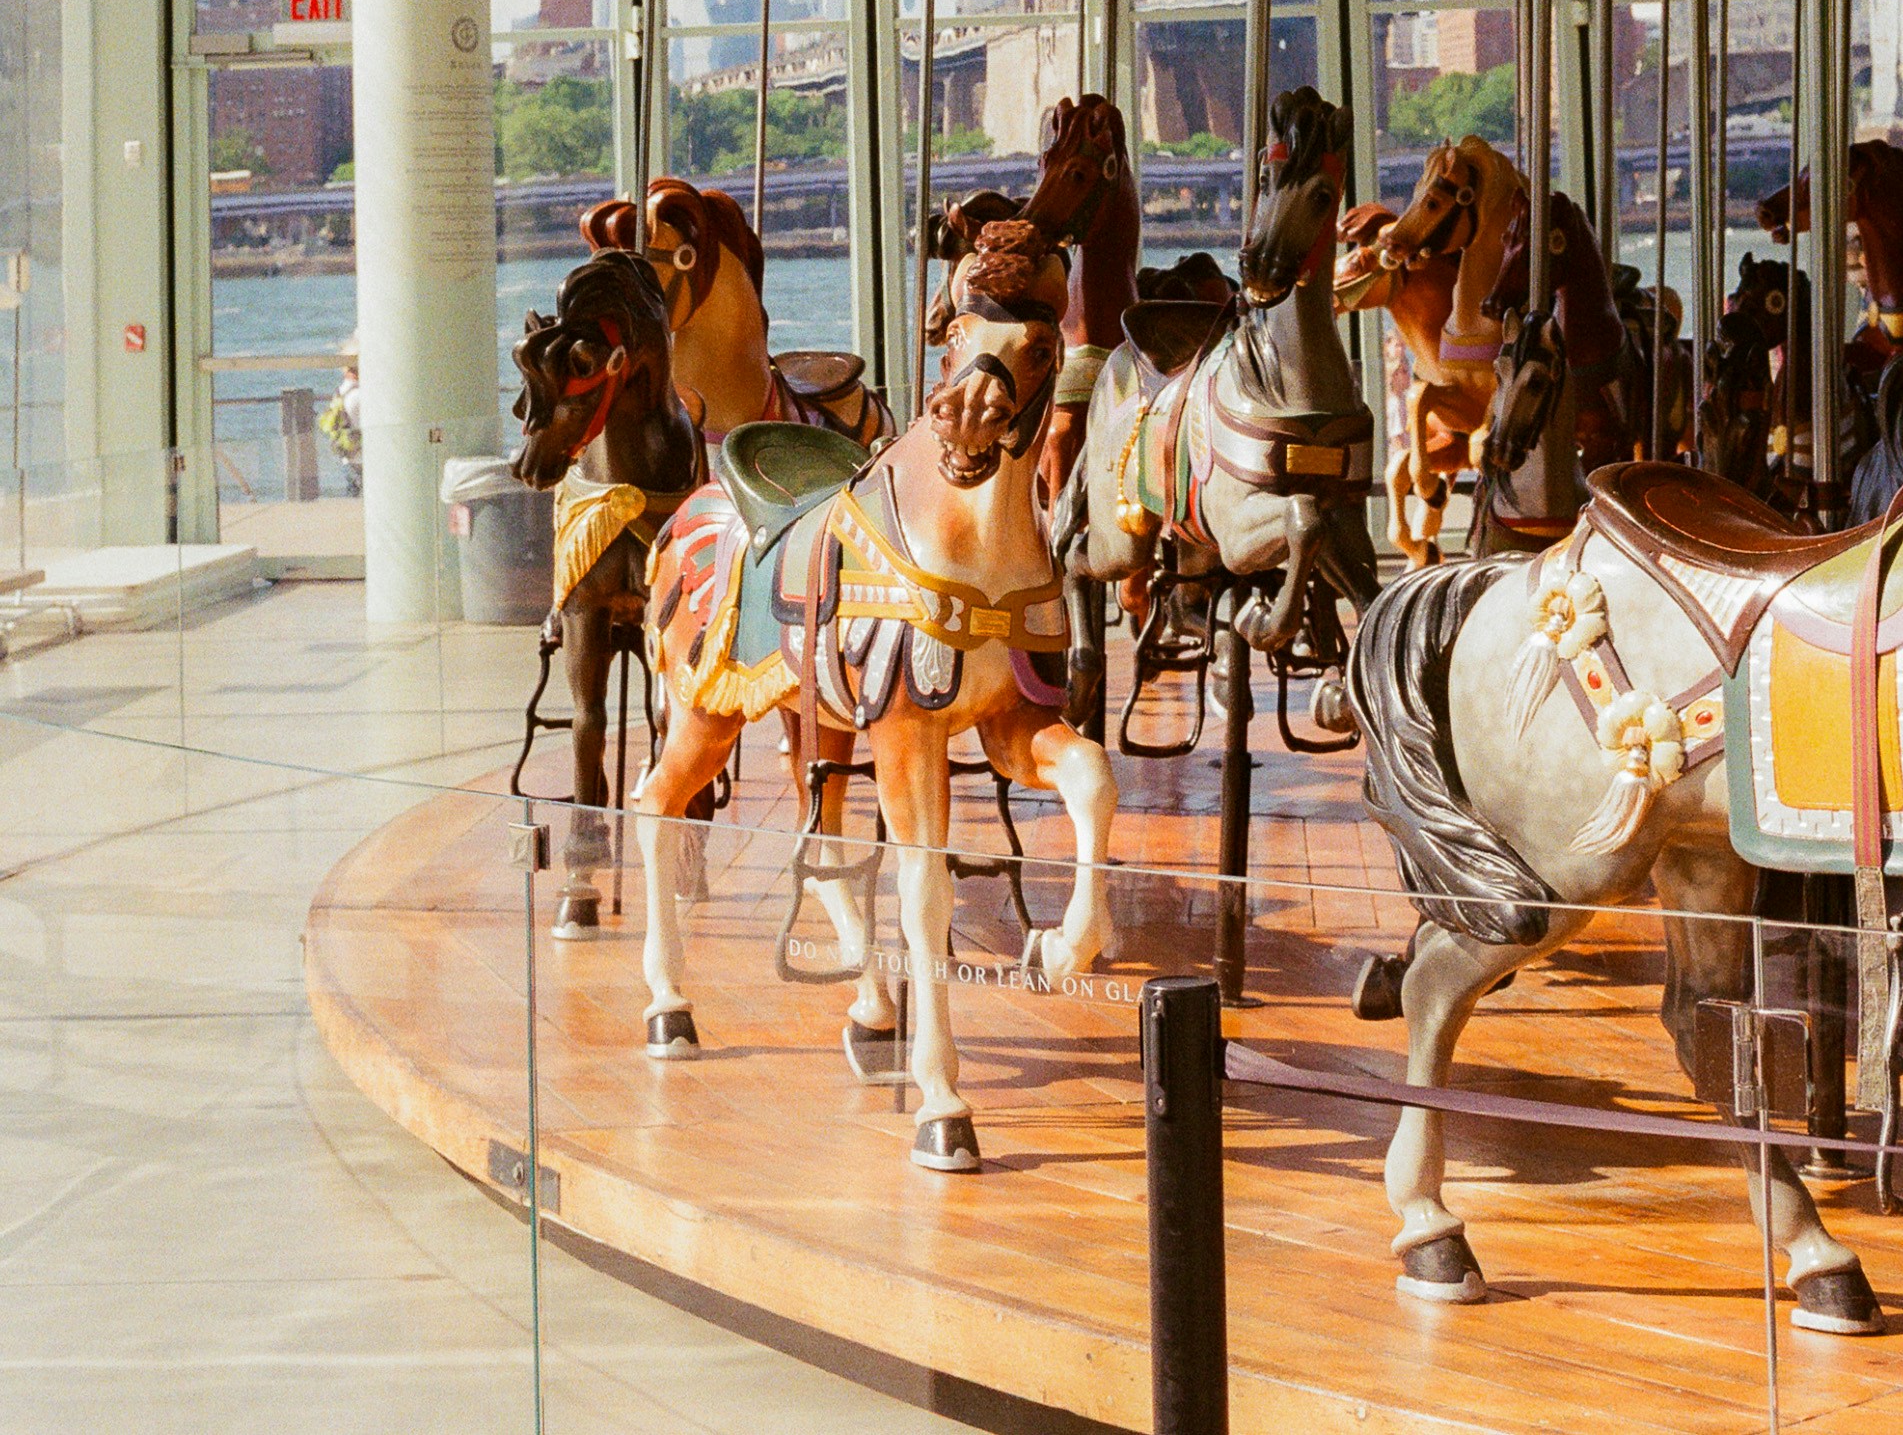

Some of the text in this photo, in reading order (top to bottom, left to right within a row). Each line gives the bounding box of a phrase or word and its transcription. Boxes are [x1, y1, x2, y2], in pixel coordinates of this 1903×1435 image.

[788, 938, 816, 959] DO
[874, 951, 947, 980] TOUH
[957, 964, 987, 985] OR
[995, 964, 1051, 993] LEAN
[1061, 976, 1094, 998] ON
